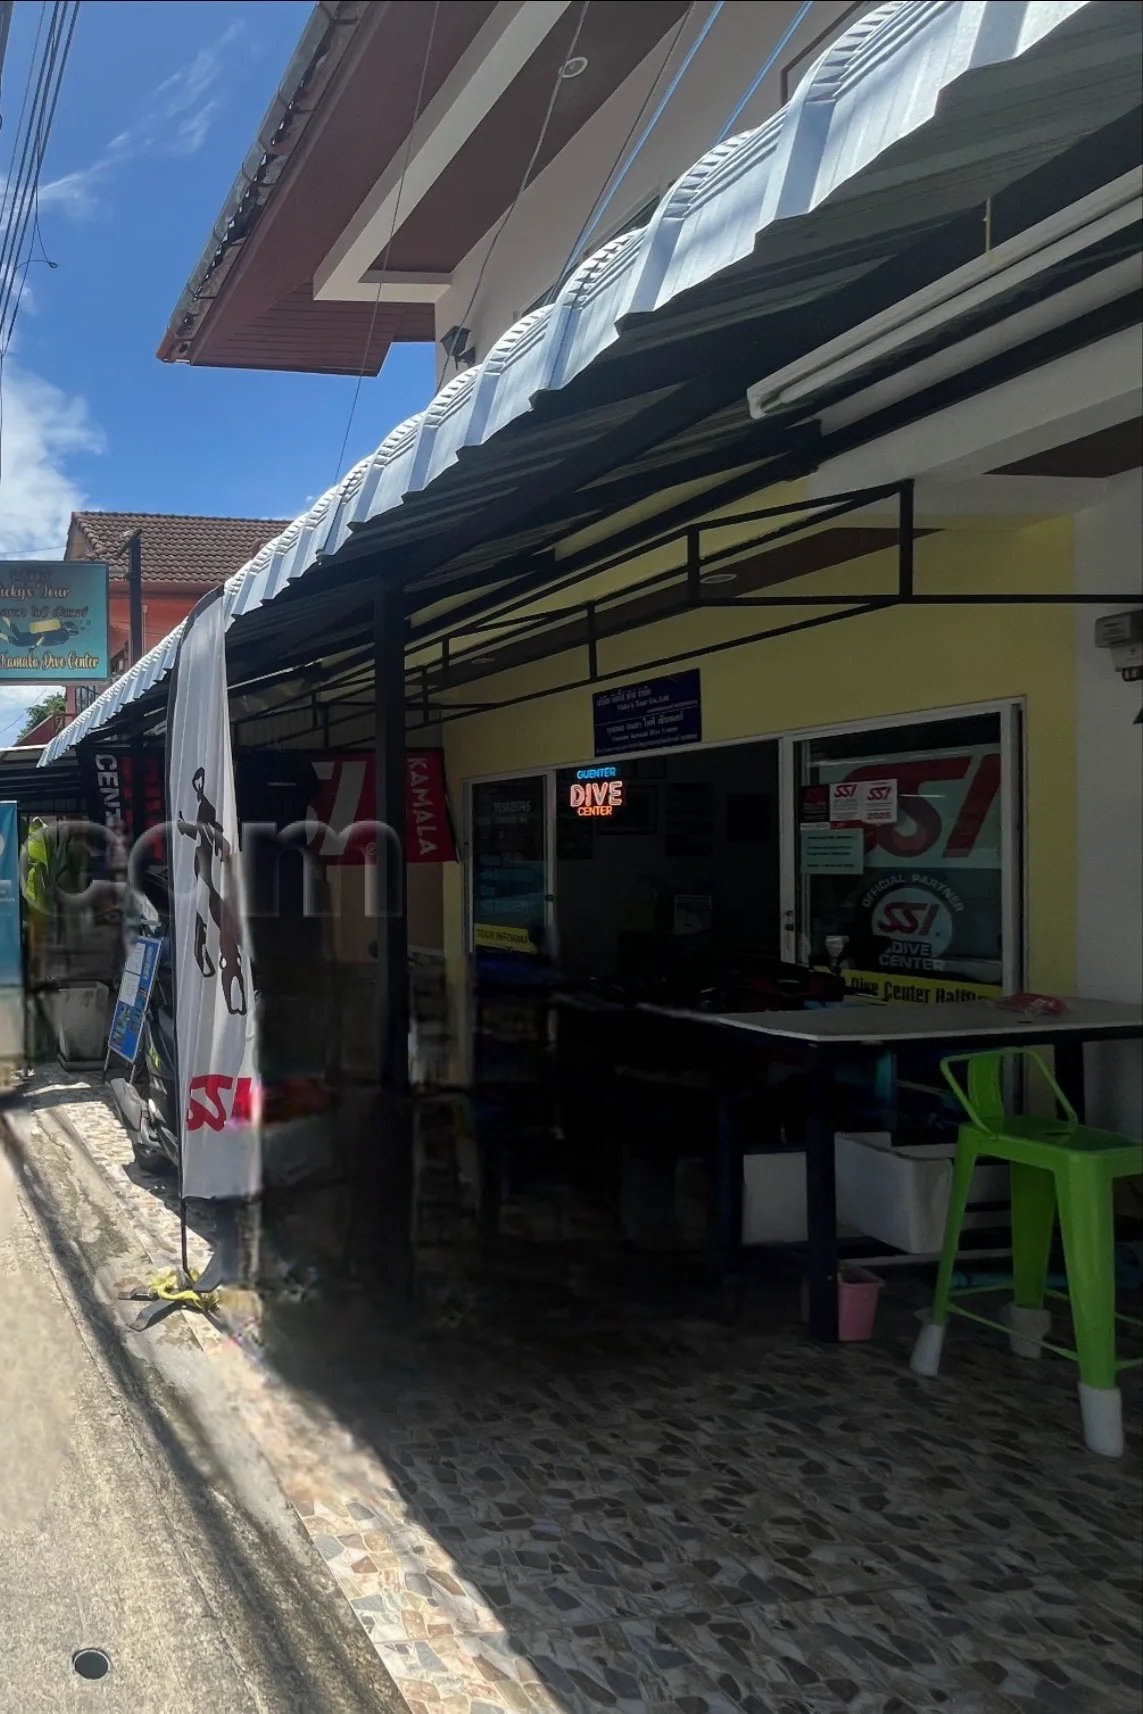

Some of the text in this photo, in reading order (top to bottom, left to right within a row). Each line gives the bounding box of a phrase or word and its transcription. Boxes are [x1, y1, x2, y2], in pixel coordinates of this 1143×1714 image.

[570, 781, 623, 807] DIVE
[406, 757, 439, 856] KAMALA
[578, 806, 613, 816] CENTER
[861, 873, 964, 912] OFFICIAL PARTNER
[877, 901, 939, 935] SSI
[892, 941, 932, 956] DIVE
[878, 953, 944, 971] CENTER
[883, 981, 930, 1003] Center
